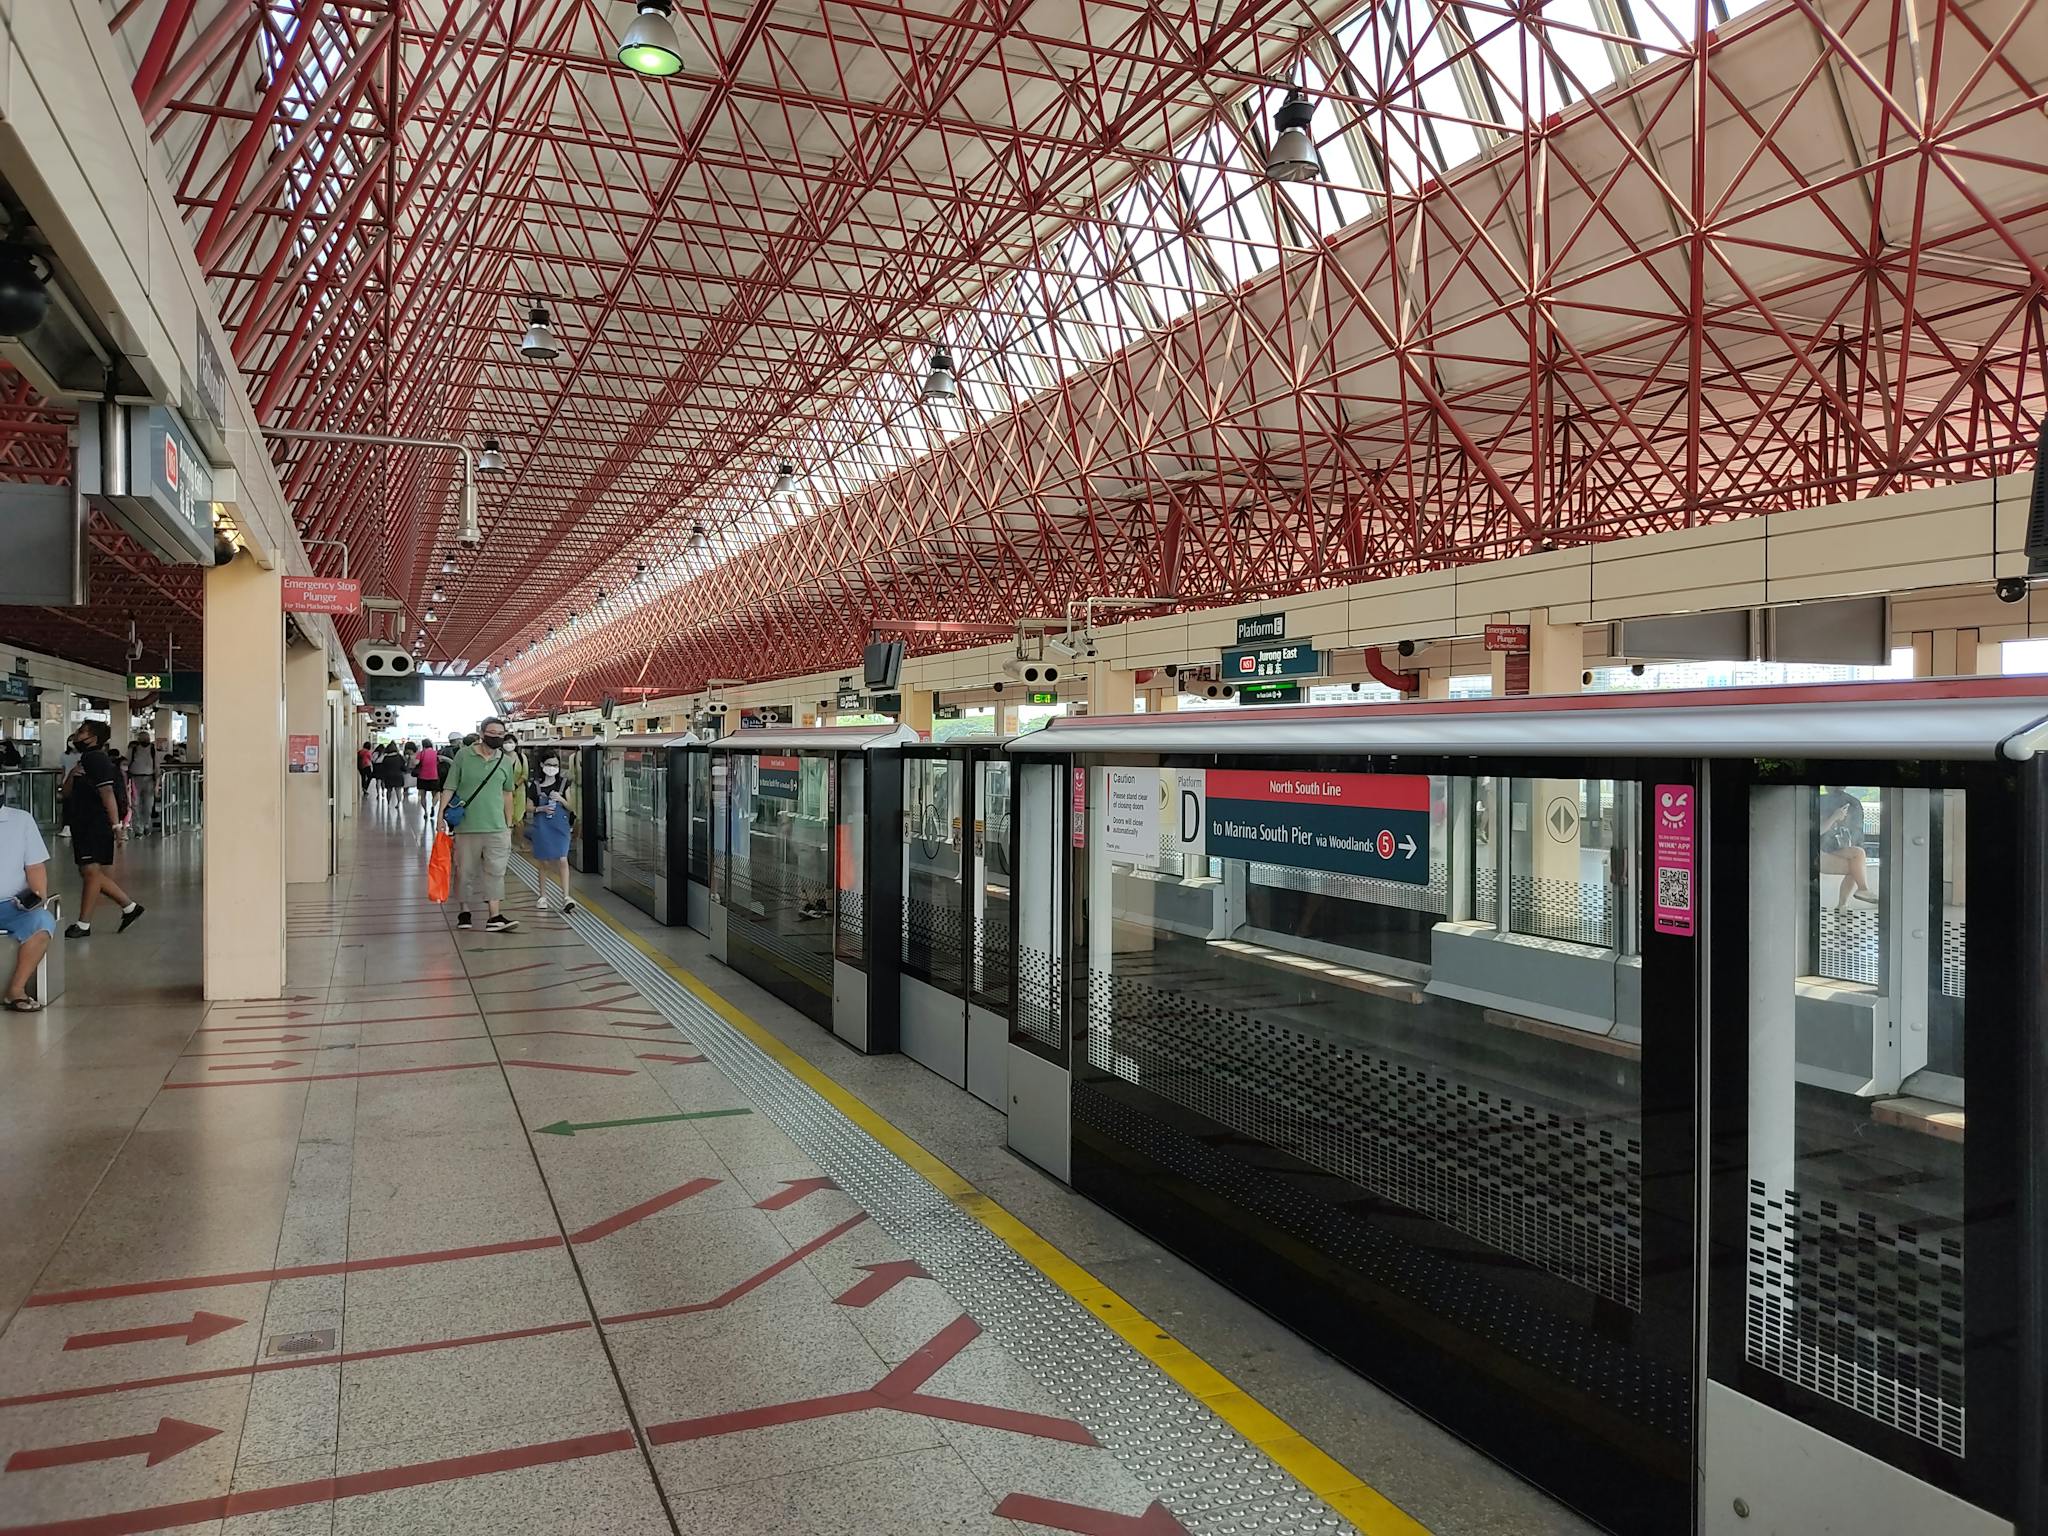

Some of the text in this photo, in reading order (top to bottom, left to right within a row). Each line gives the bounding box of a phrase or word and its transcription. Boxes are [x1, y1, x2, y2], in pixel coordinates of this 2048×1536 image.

[284, 579, 357, 592] Emergency Stop
[303, 591, 337, 603] Plunger
[1238, 620, 1273, 639] Platform
[1486, 626, 1528, 635] Emergency Stop
[1496, 635, 1517, 644] Plunger
[1258, 647, 1298, 662] Jurong East
[1242, 660, 1253, 669] NS1
[135, 676, 161, 689] Exit
[1113, 772, 1136, 784] Caution
[1178, 775, 1202, 788] Platform
[1269, 780, 1342, 796] North South Line
[1181, 790, 1200, 843] D
[1213, 820, 1389, 853] to Marina South Pier via Woodlands 5
